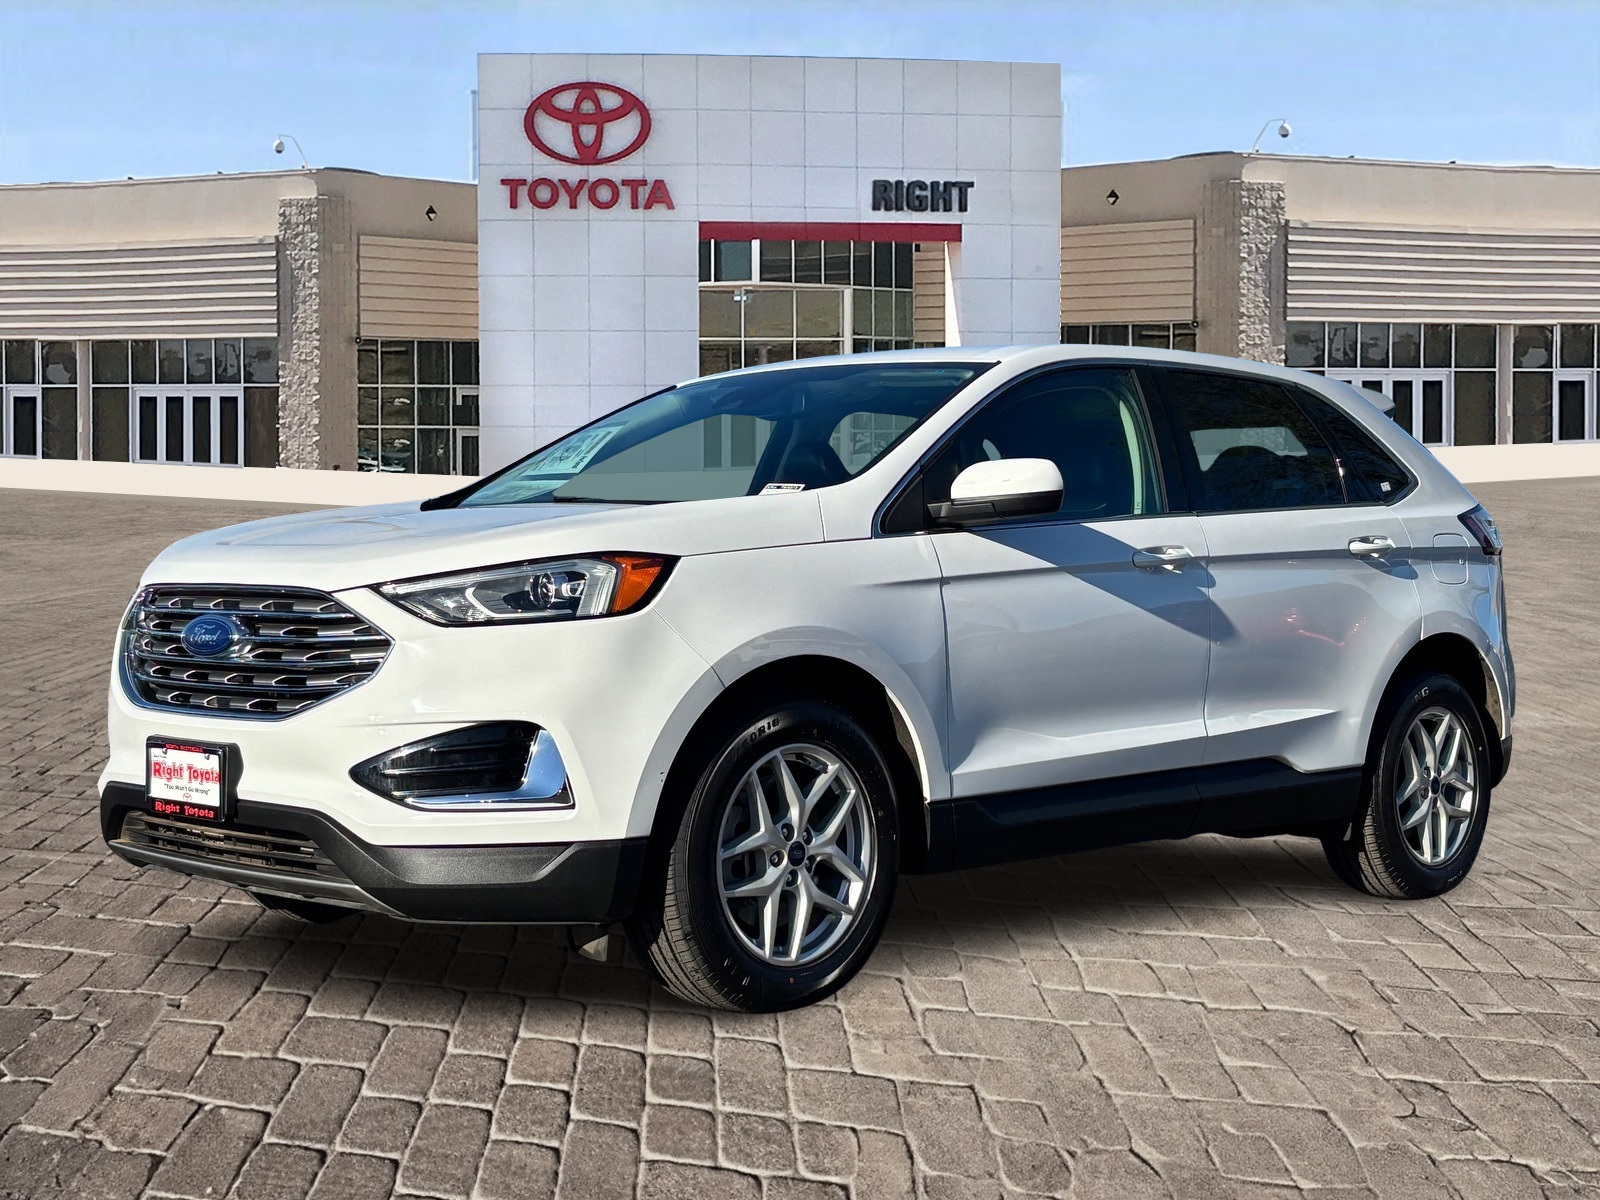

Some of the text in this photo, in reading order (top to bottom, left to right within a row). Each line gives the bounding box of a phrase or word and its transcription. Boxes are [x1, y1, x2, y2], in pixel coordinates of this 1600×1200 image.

[500, 178, 676, 210] TOYOTA
[871, 179, 975, 213] RIGHT
[190, 623, 222, 645] Ford
[153, 761, 221, 785] Right Toyota
[155, 801, 215, 819] Right Toyota
